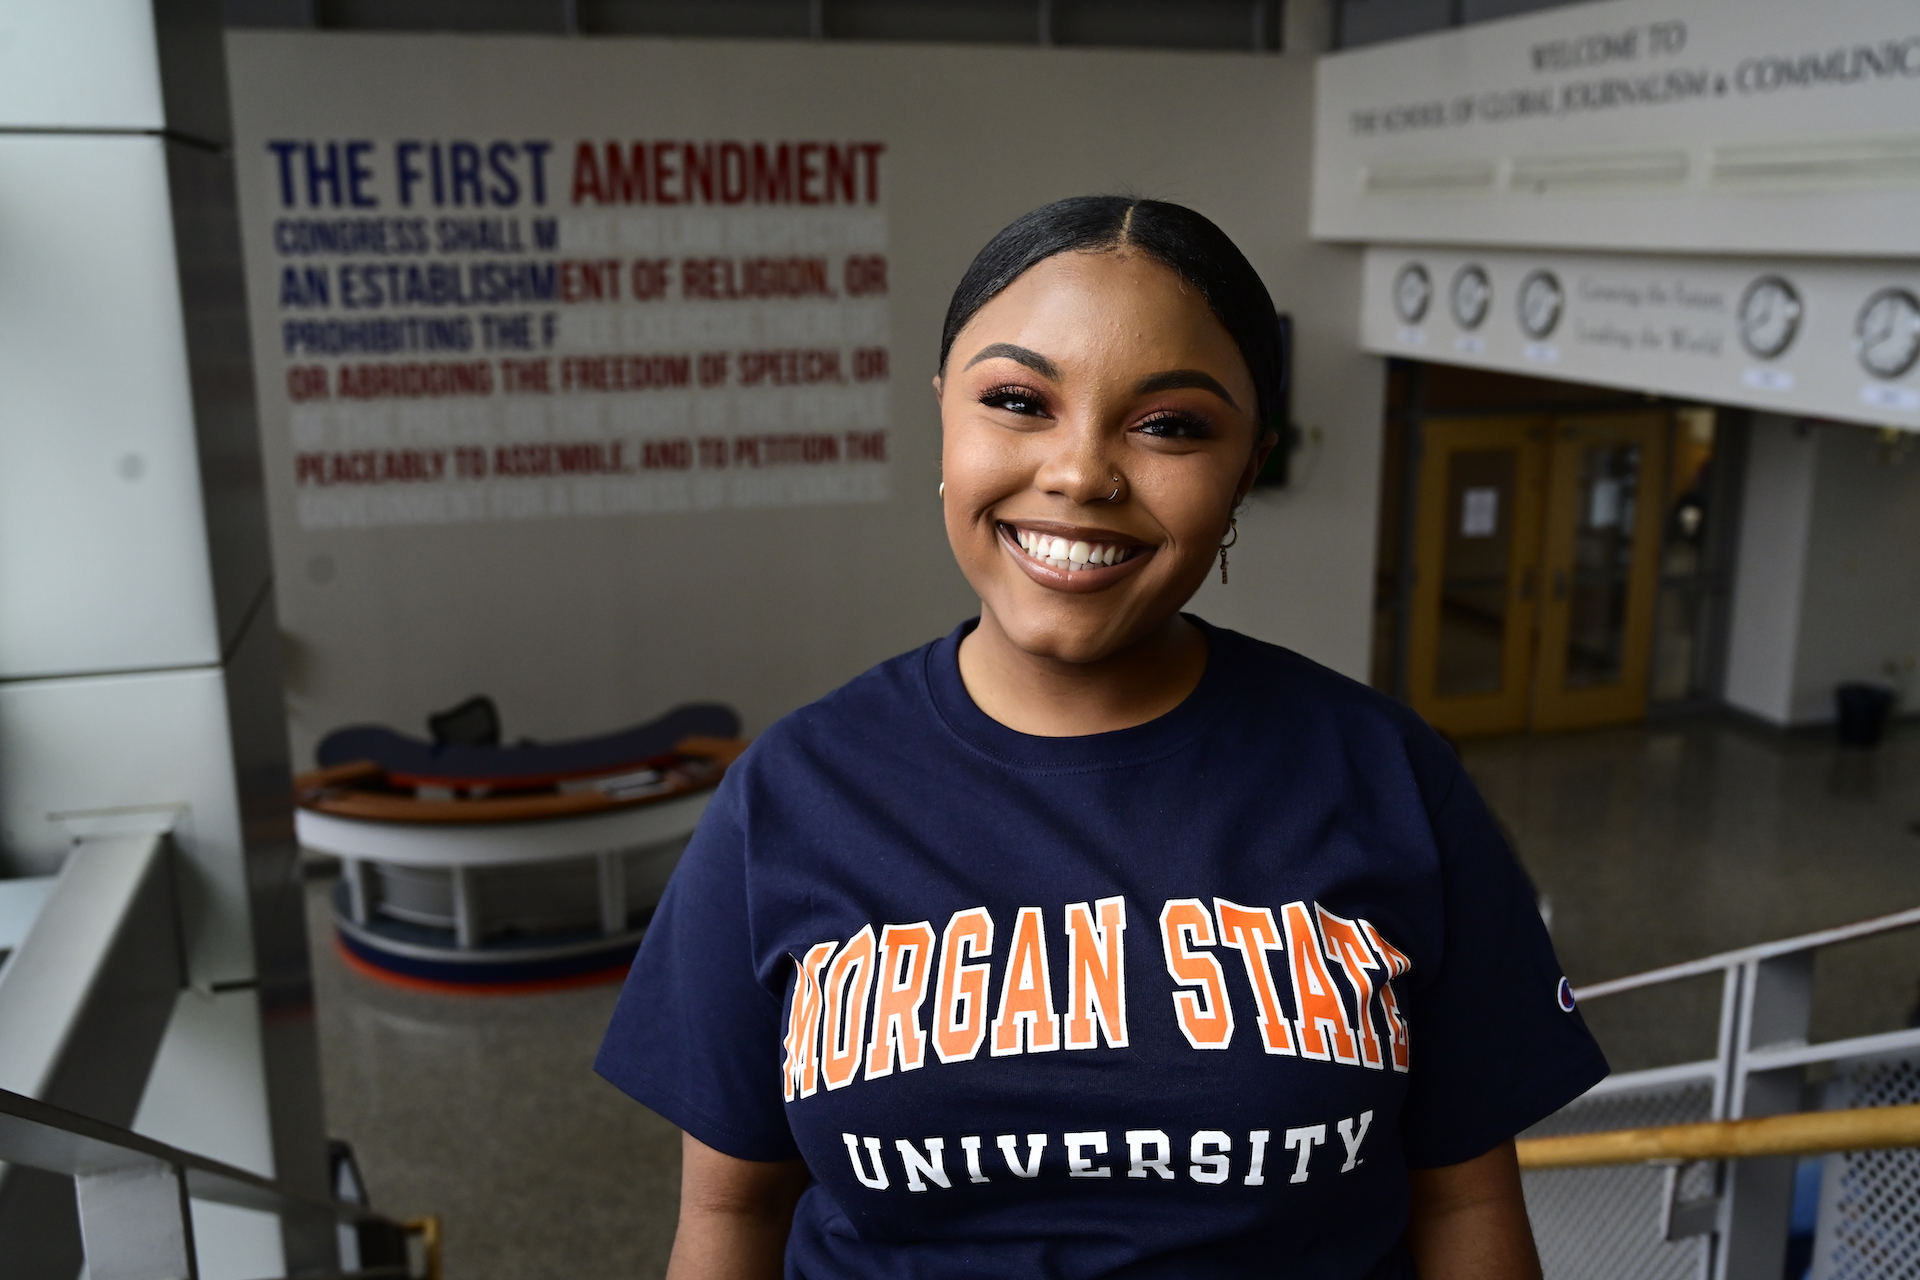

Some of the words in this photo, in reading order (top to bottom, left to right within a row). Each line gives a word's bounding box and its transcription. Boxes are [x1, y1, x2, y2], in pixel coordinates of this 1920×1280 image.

[1530, 27, 1638, 72] WELCOME
[1648, 18, 1688, 57] TO
[1557, 68, 1708, 119] JOURNALISM
[266, 138, 379, 209] THE
[395, 138, 553, 208] FIRST
[571, 137, 888, 208] AMENDMENT
[273, 216, 428, 255] CONGRESS
[437, 216, 525, 253] SHALL
[281, 262, 330, 308] AN
[338, 256, 621, 308] ESTABLISHMENT
[631, 257, 672, 302] OF
[681, 256, 838, 302] RELIGION,
[844, 254, 889, 299] OR
[284, 316, 470, 358] PROHIBITING
[480, 314, 534, 352] THE
[287, 362, 331, 404] OR
[337, 357, 494, 402] ABRIDGING
[501, 356, 553, 396] THE
[560, 353, 692, 394] FREEDOM
[698, 351, 730, 389] OF
[736, 348, 848, 388] SPEECH,
[852, 345, 889, 385] OR
[295, 448, 446, 488] PEACEABLY
[453, 445, 489, 482] TO
[493, 438, 636, 480] ASSEMBLE,
[640, 436, 692, 473] AND
[697, 433, 730, 471] TO
[733, 430, 840, 470] PETITION
[844, 429, 889, 466] THE
[783, 895, 1130, 1103] MORGAN
[1158, 896, 1412, 1074] STATE
[842, 1108, 1374, 1193] UNIVERSITY
